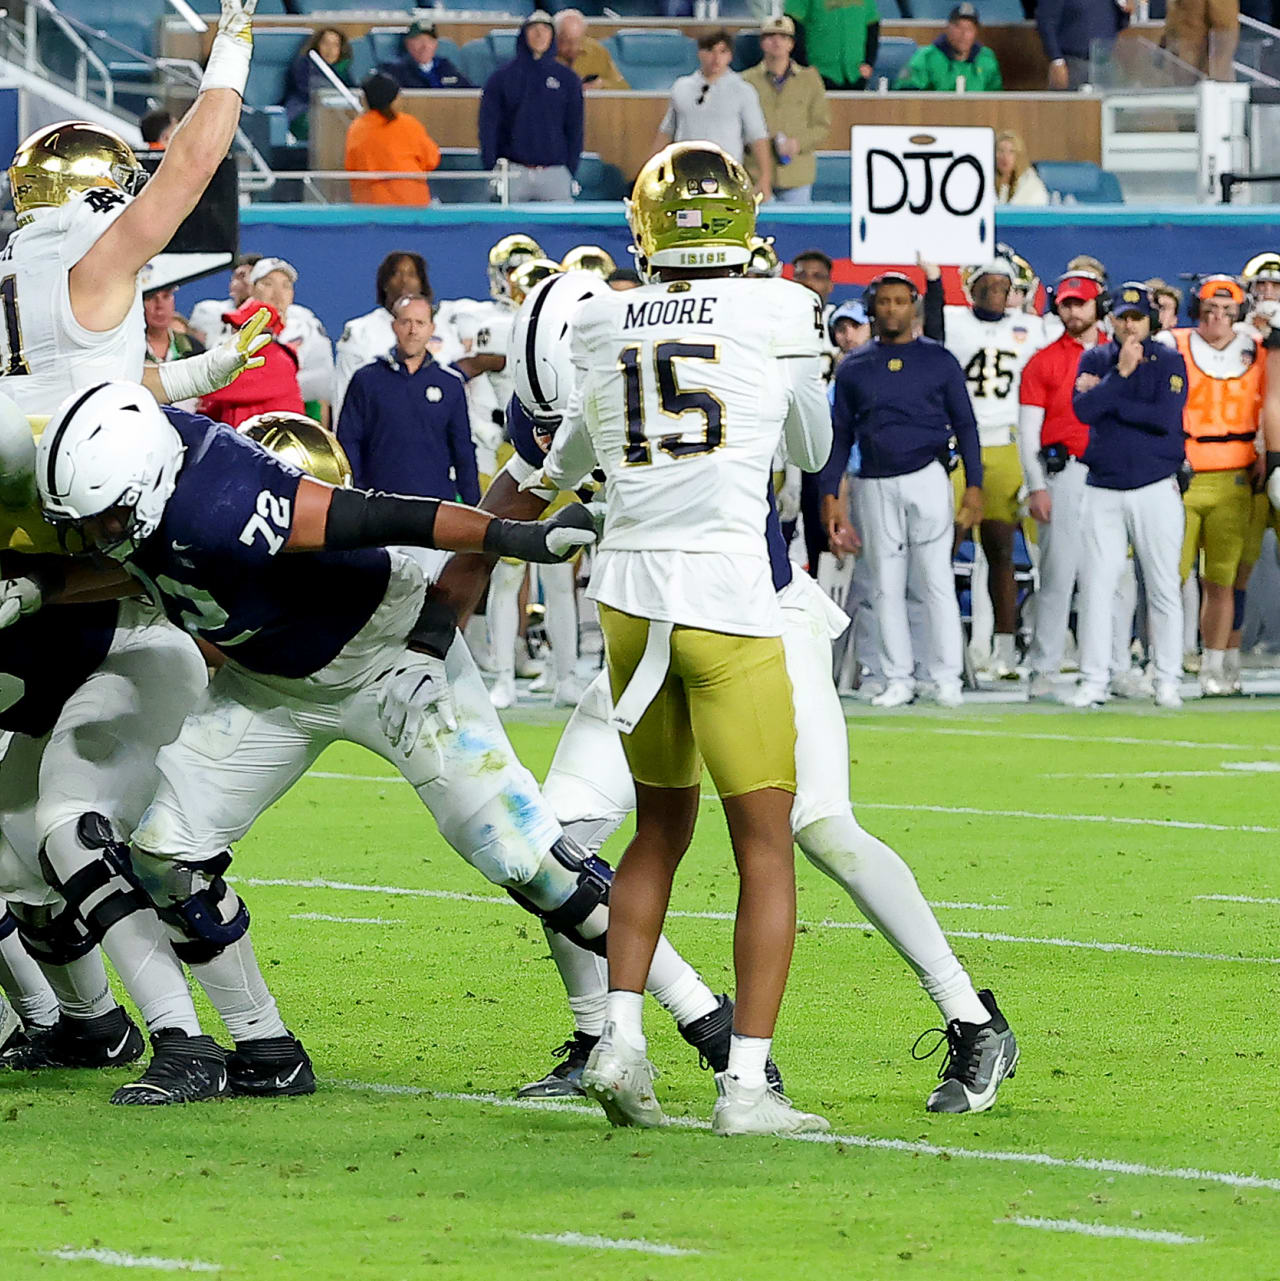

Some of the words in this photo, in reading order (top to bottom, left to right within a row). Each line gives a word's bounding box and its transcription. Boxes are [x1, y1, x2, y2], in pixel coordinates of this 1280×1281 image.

[866, 149, 986, 217] DJO
[679, 251, 727, 265] IRISH
[623, 297, 718, 330] MOORE
[616, 338, 728, 467] 15
[964, 346, 1019, 400] 45
[237, 488, 292, 557] 72
